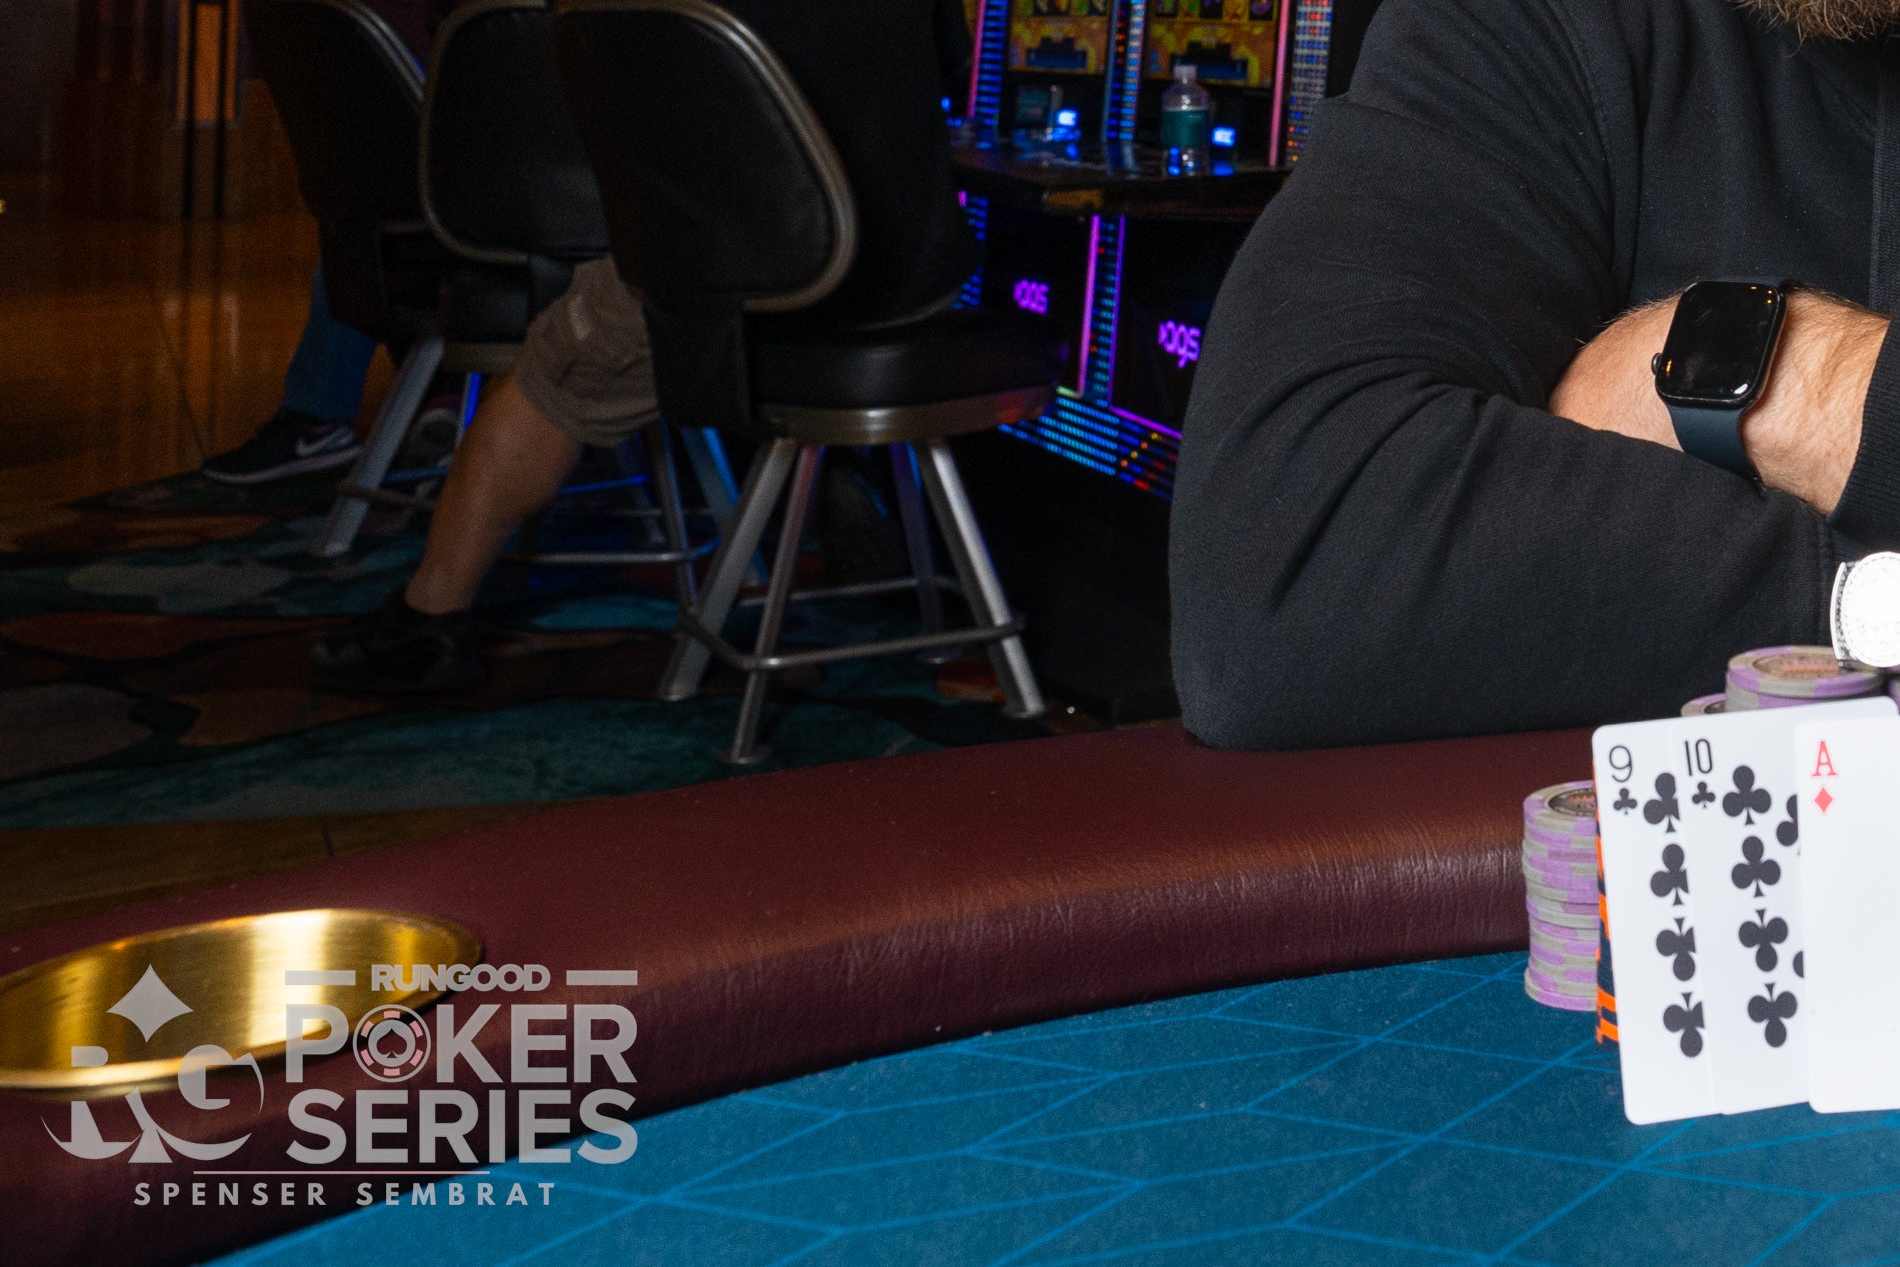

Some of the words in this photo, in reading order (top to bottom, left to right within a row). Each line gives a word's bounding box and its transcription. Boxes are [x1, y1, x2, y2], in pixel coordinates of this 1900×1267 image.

[1608, 745, 1633, 783] 9
[1685, 737, 1713, 776] 10
[1811, 739, 1838, 778] A
